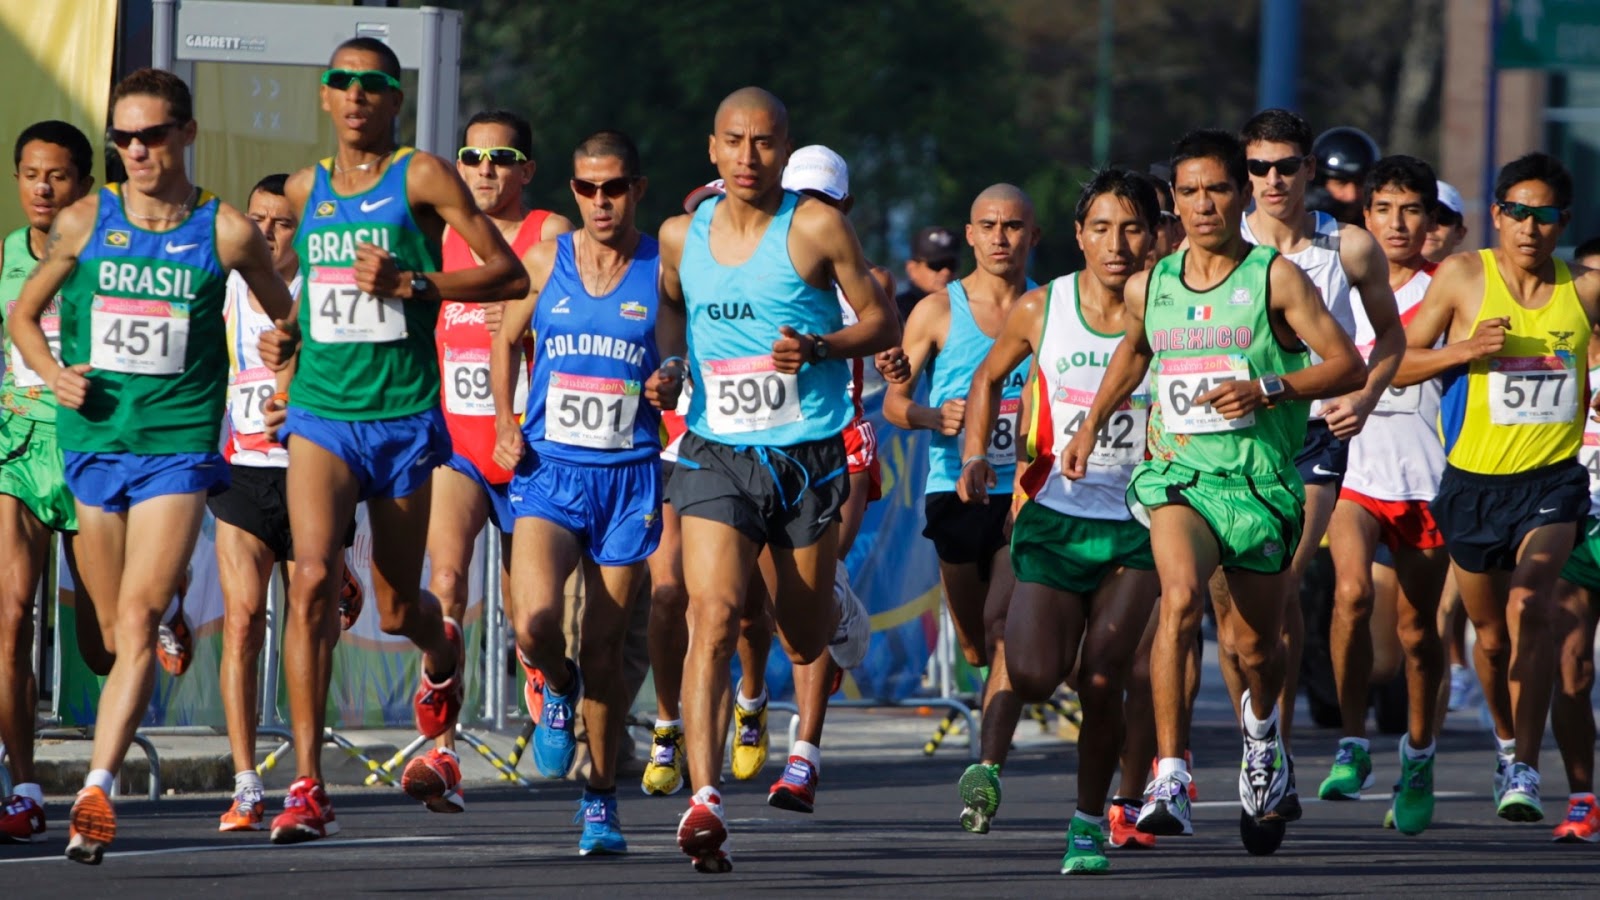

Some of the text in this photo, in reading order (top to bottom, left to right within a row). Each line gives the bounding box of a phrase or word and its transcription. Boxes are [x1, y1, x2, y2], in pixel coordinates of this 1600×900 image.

[185, 34, 241, 50] GARRETT
[98, 260, 196, 299] BRASIL
[319, 288, 386, 325] 471
[444, 302, 485, 331] Puert
[707, 302, 756, 321] GUA
[102, 318, 170, 358] 451
[545, 333, 647, 367] COLOMBIA
[1152, 325, 1252, 354] MEXICO
[1056, 351, 1110, 375] BOLI
[454, 366, 492, 400] 69
[718, 374, 786, 416] 590
[1503, 373, 1568, 409] 577
[240, 384, 275, 418] 78
[558, 393, 624, 432] 501
